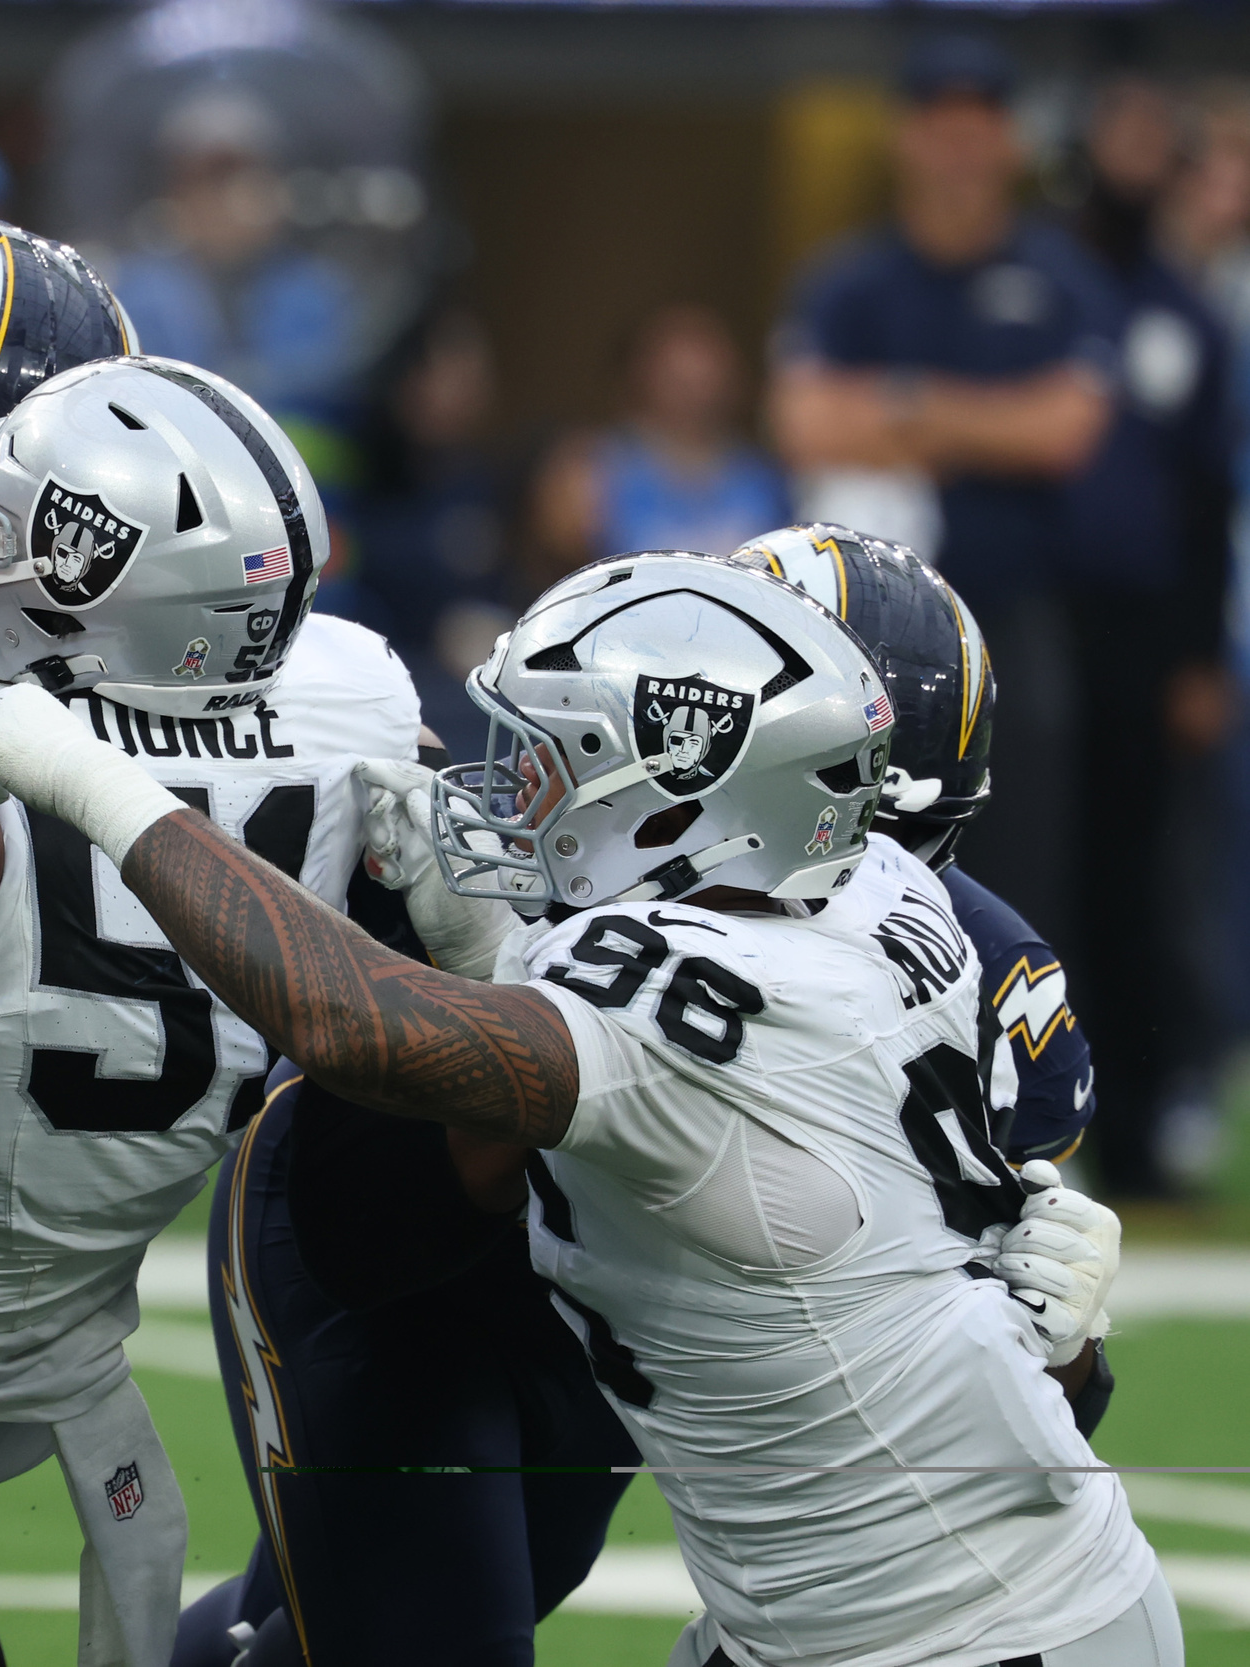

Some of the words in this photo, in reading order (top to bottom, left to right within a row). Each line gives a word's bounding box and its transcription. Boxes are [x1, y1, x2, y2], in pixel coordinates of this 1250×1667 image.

[50, 488, 131, 540] RAIDERS
[251, 616, 274, 631] CD
[184, 657, 201, 668] NFL
[647, 680, 744, 709] RAIDERS
[816, 829, 831, 842] NFL
[111, 1483, 141, 1517] NFL
